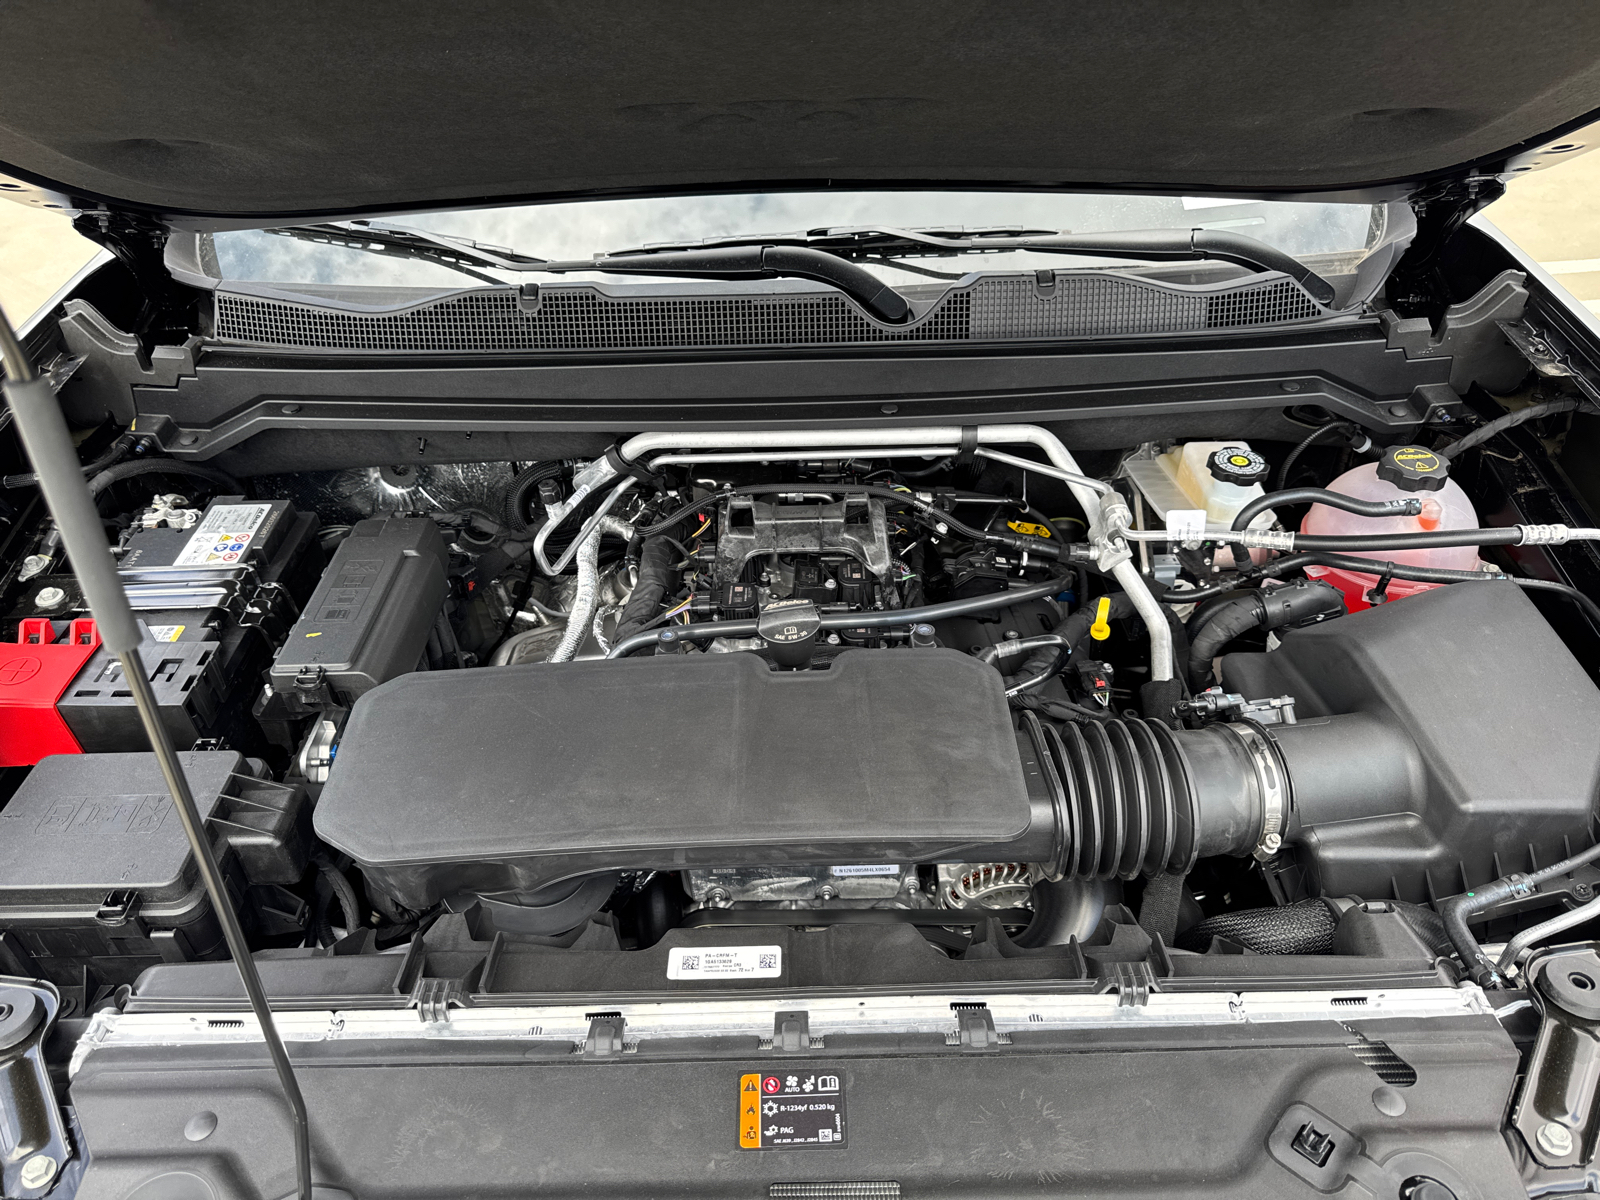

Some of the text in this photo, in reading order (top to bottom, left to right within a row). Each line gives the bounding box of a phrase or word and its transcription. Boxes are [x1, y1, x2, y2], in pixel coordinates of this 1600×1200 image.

[248, 507, 265, 530] ACDelco
[763, 599, 809, 611] ACDelco
[780, 1104, 807, 1112] R-1234yf
[827, 1103, 836, 1111] kg
[780, 1126, 794, 1134] PAG
